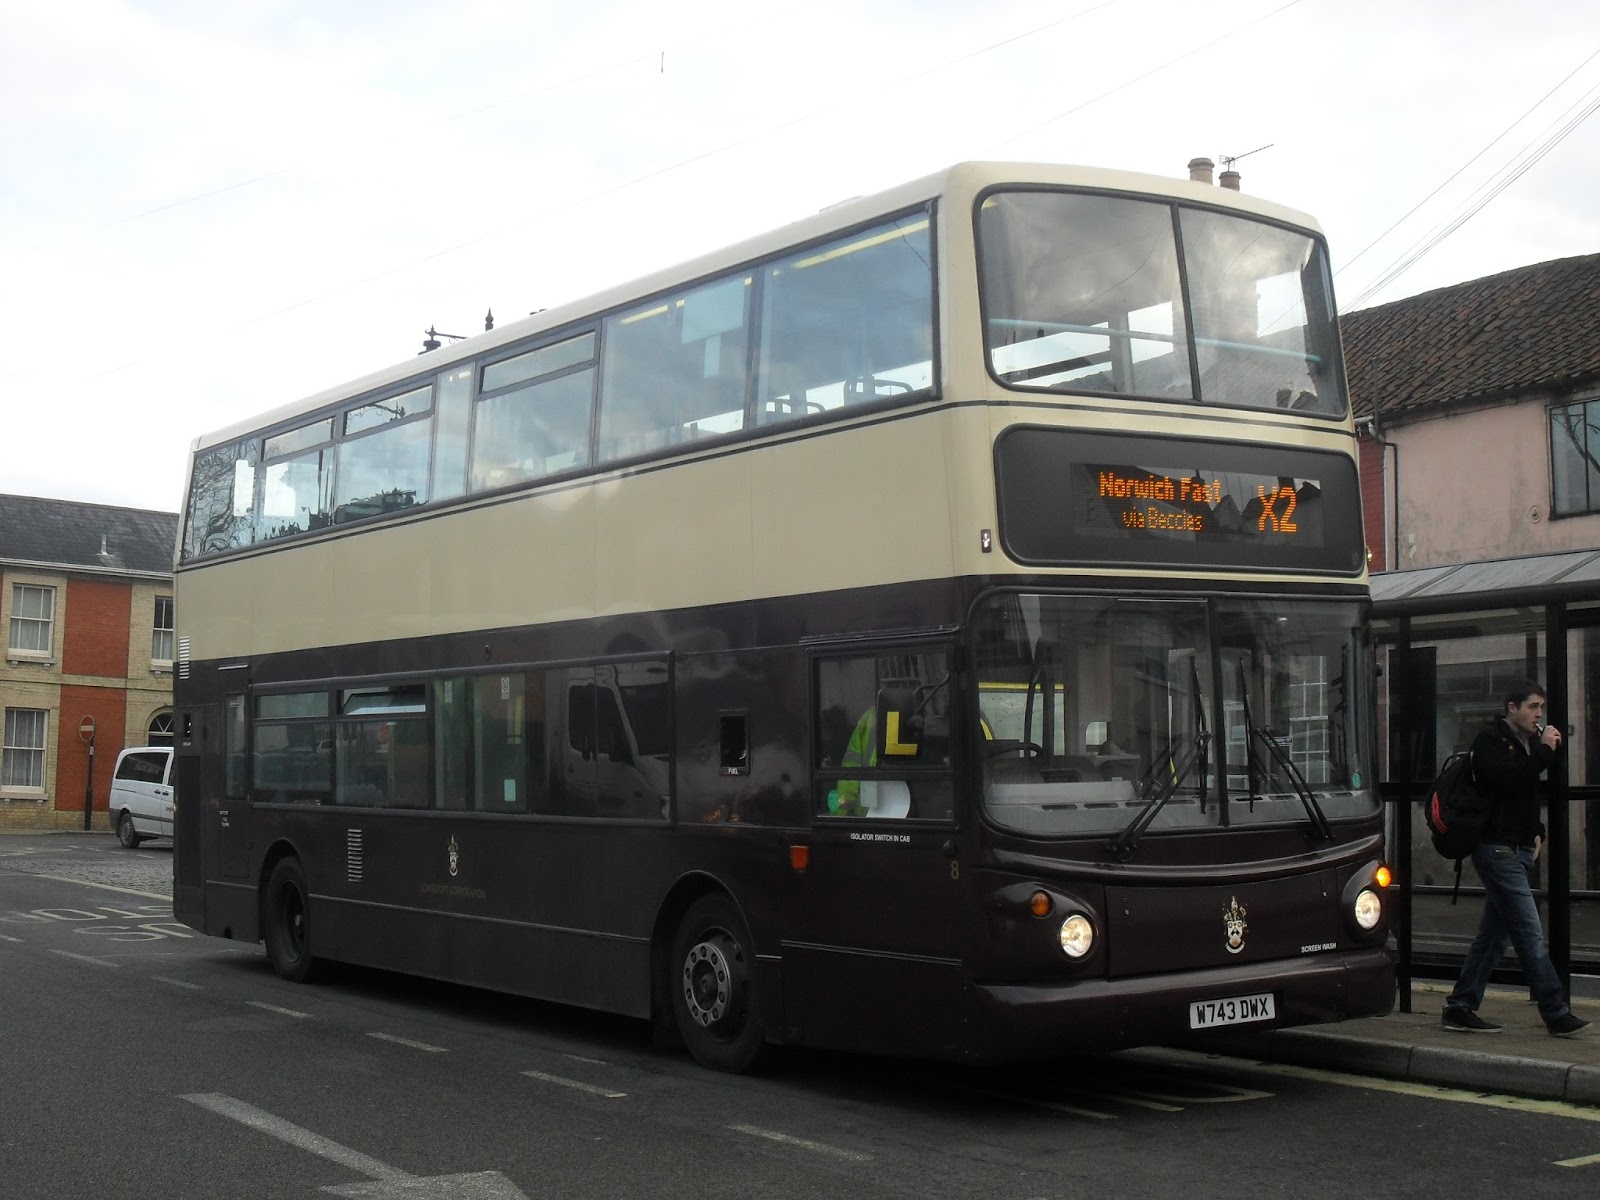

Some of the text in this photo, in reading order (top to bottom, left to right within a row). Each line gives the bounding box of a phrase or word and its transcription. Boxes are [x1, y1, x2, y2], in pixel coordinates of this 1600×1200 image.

[1100, 471, 1175, 500] Norwich
[1258, 485, 1298, 533] X2
[885, 711, 918, 756] L
[850, 832, 911, 843] ISOLATOR SWITCH IN CAB
[951, 860, 960, 880] 8
[1301, 942, 1337, 953] SCREEN WASH
[1196, 997, 1270, 1025] W743 DWX
